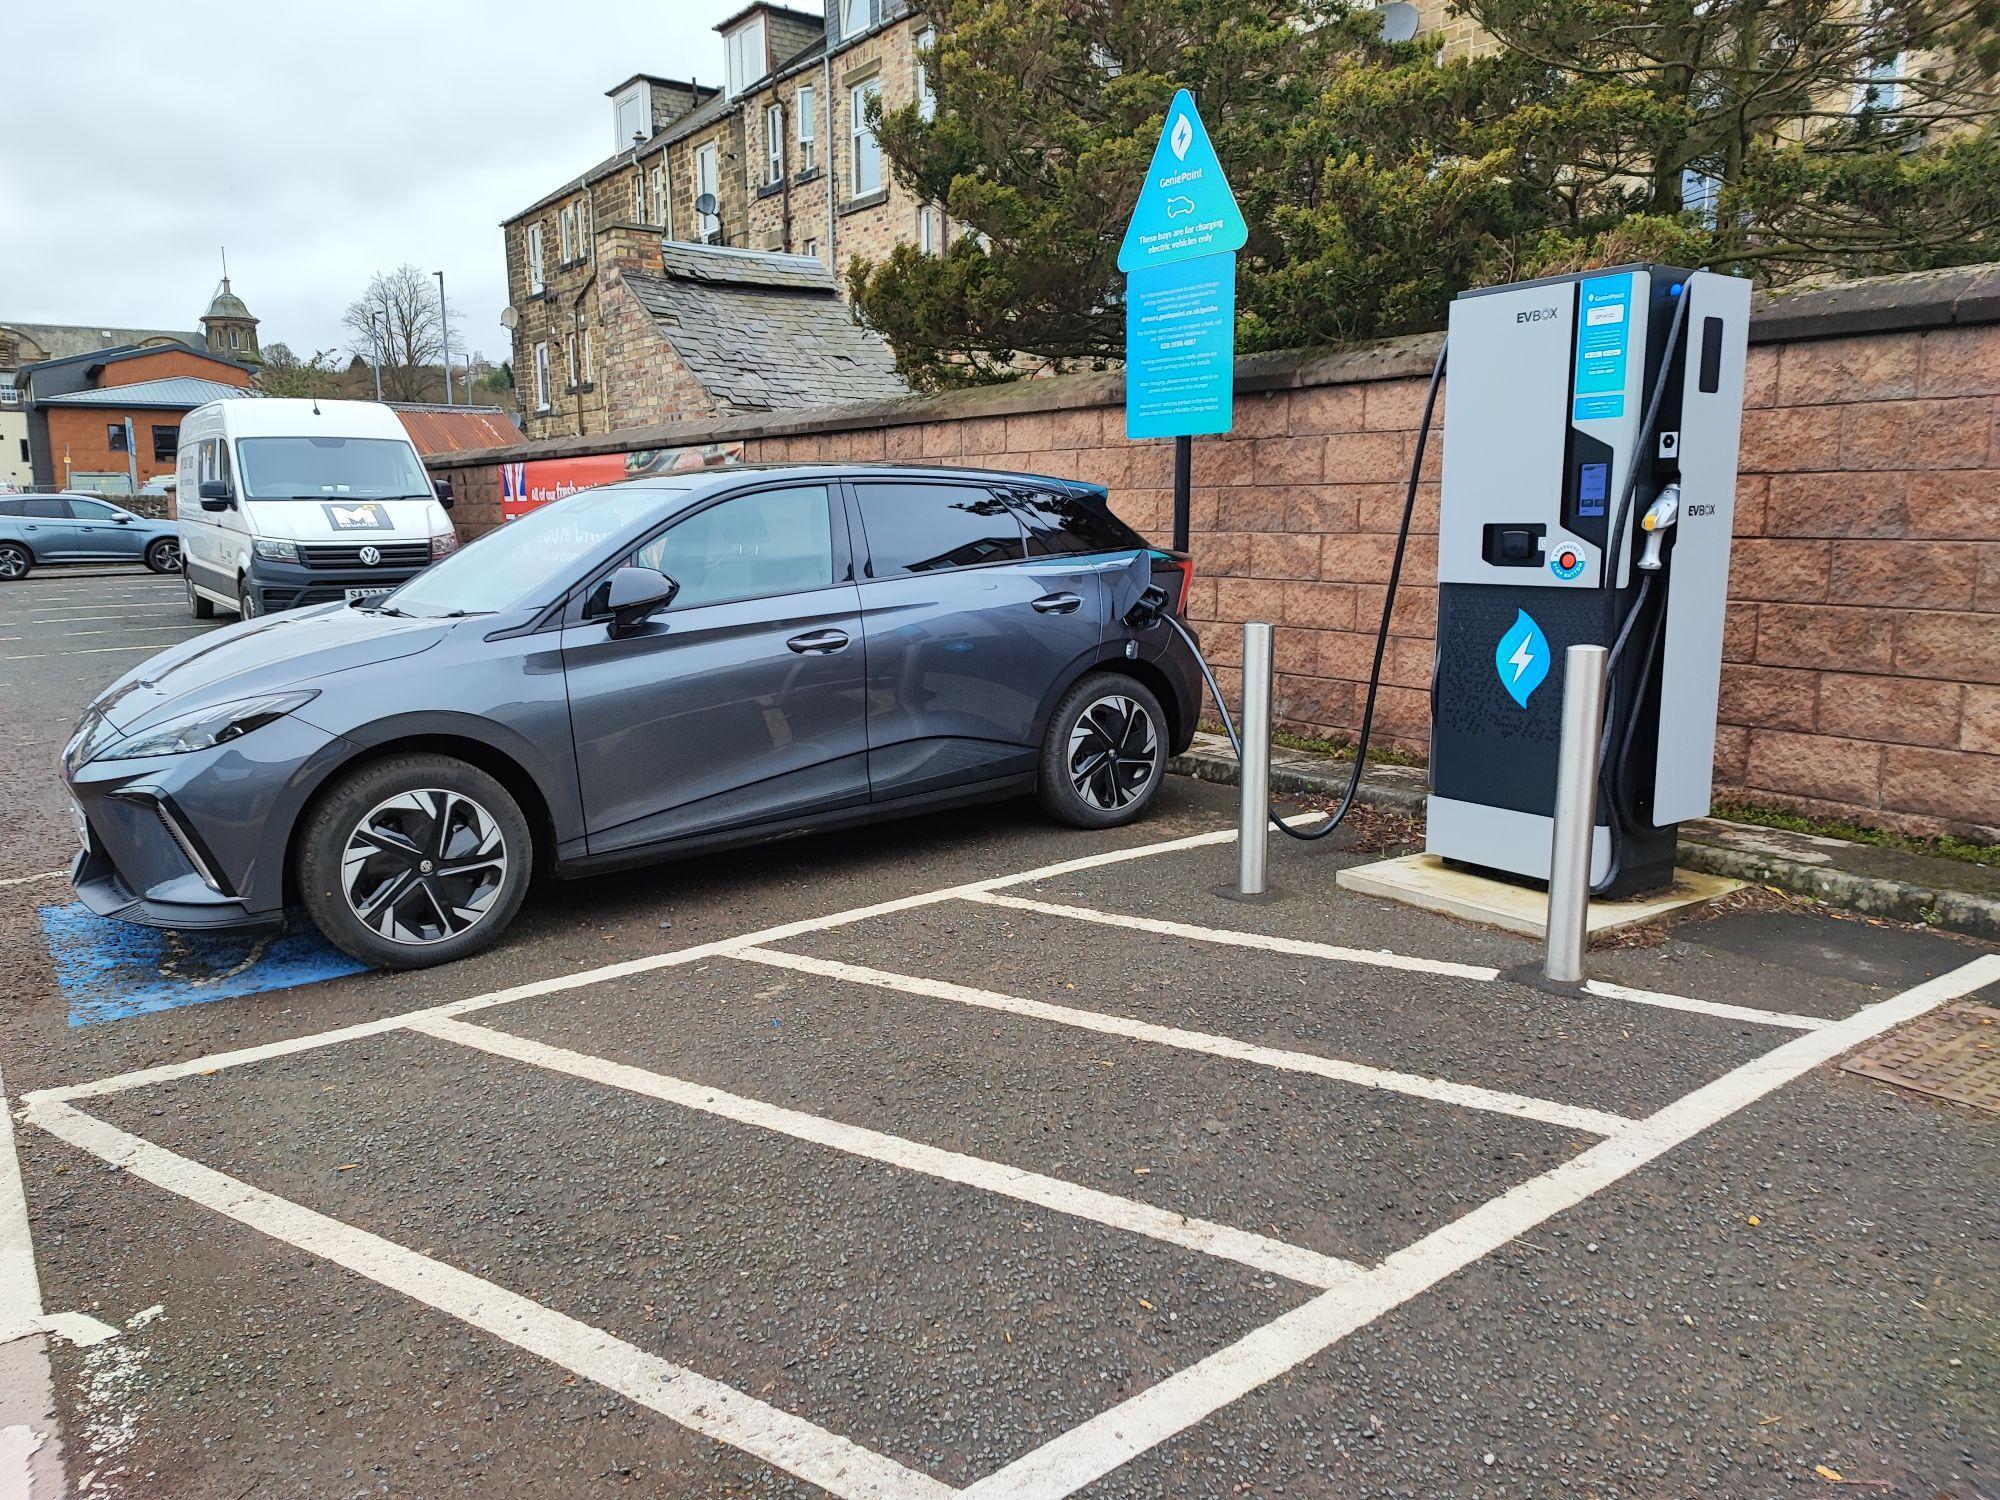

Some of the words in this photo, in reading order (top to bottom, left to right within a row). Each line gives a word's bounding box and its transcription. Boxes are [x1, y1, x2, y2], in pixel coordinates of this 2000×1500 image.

[1160, 168, 1203, 188] GeniePoint
[1139, 235, 1157, 245] These
[1158, 231, 1173, 241] bays
[1173, 229, 1184, 237] are
[1184, 225, 1194, 235] for
[1195, 219, 1224, 231] charging
[1148, 242, 1170, 254] electric
[1171, 236, 1197, 249] vehicles
[1198, 233, 1213, 243] only
[556, 480, 577, 500] fresh
[1553, 544, 1582, 557] EMERGENCY
